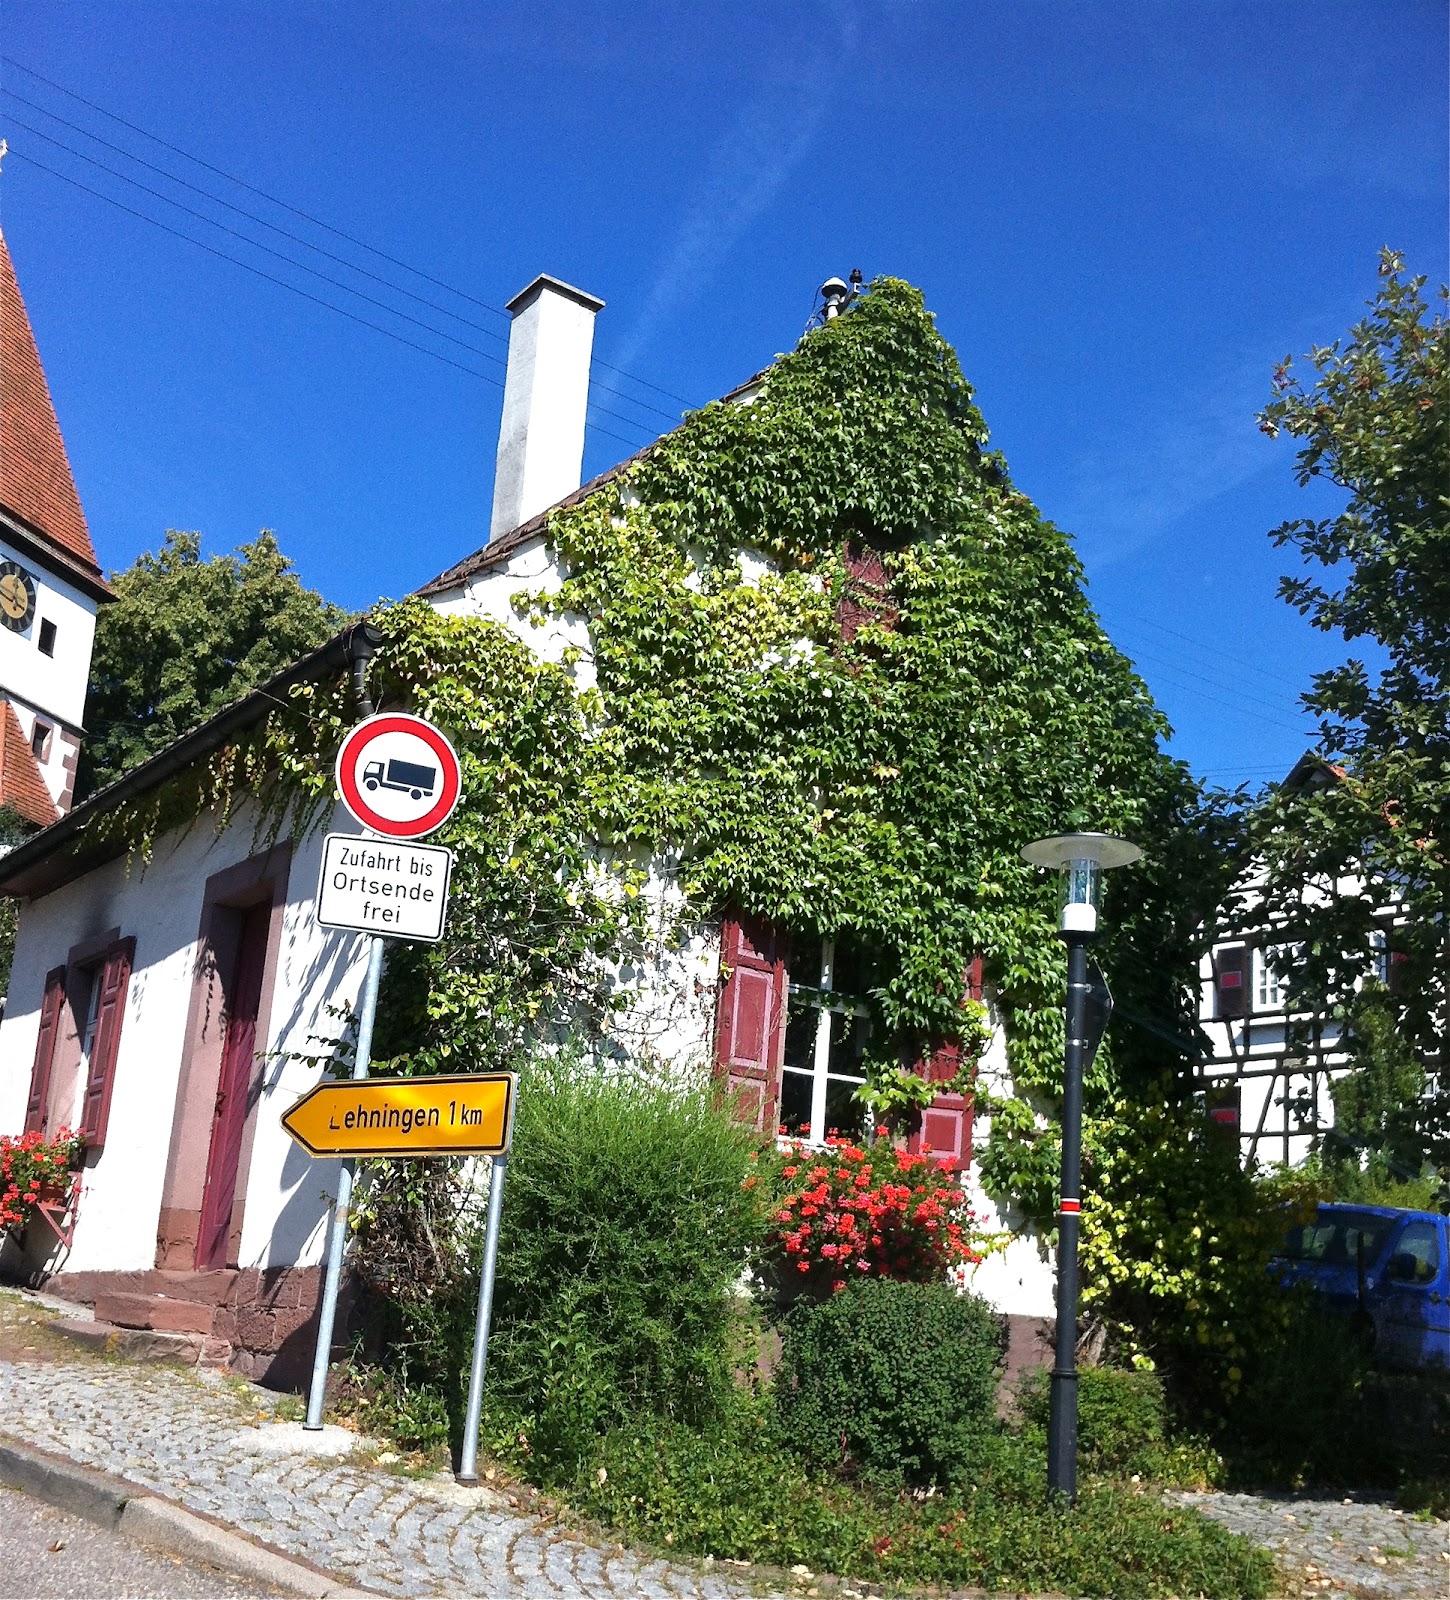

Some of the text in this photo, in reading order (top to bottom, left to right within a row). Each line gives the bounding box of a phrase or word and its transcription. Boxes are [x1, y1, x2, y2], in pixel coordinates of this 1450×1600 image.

[340, 847, 433, 877] Zufahrt bis
[333, 872, 434, 902] Ortsende
[363, 901, 401, 923] frei
[448, 1100, 457, 1126] 1
[461, 1103, 483, 1125] km
